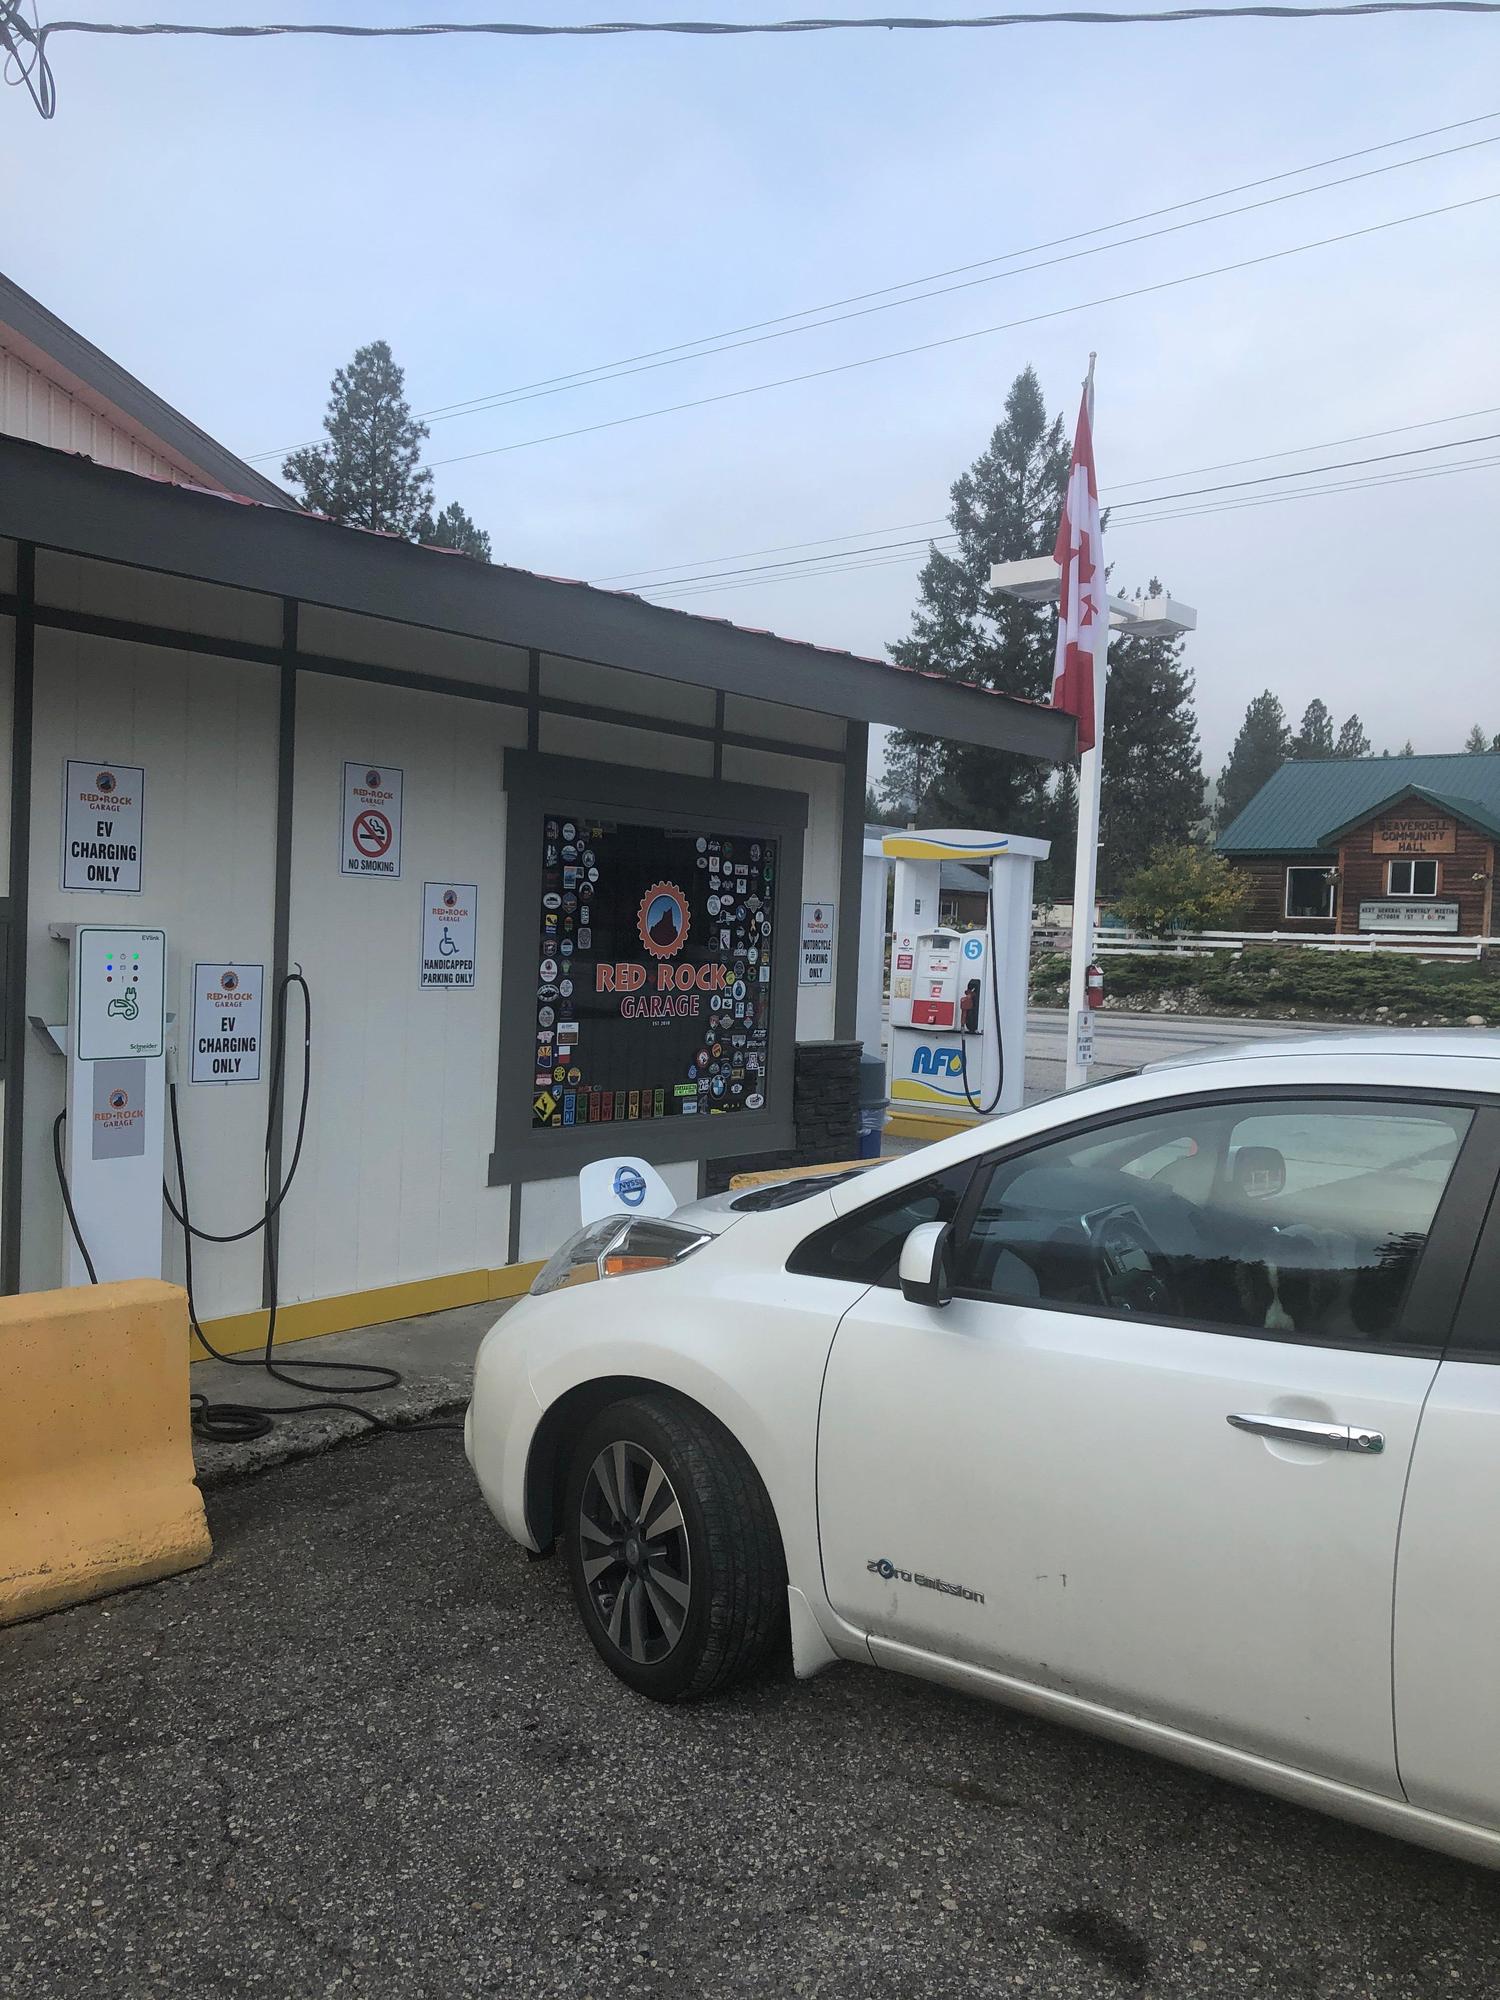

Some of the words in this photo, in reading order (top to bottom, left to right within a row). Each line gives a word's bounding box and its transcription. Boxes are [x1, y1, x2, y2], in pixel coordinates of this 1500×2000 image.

[360, 797, 384, 805] GARAGE
[89, 803, 121, 812] GARAGE
[96, 821, 113, 837] EV
[1380, 821, 1449, 831] BEAVERDELL
[1382, 831, 1445, 841] COMMUNITY
[71, 841, 137, 861] CHARGING
[1398, 842, 1426, 852] HALL
[348, 859, 359, 869] NO
[360, 860, 394, 872] SMOKING
[87, 864, 120, 882] ONLY
[803, 940, 831, 950] MOTORCYCLE
[968, 942, 979, 958] 5
[805, 954, 828, 964] PARKING
[424, 959, 473, 970] HANDICAPPED
[423, 973, 454, 983] PARKING
[455, 973, 473, 983] ONLY
[596, 963, 647, 992] RED
[657, 963, 728, 992] ROCK
[809, 968, 823, 978] ONLY
[620, 995, 700, 1019] GARAGE
[221, 1017, 236, 1032] EV
[130, 1043, 157, 1051] Schneider
[198, 1037, 257, 1053] CHARGING
[212, 1058, 241, 1074] ONLY
[103, 1120, 134, 1128] GARAGE
